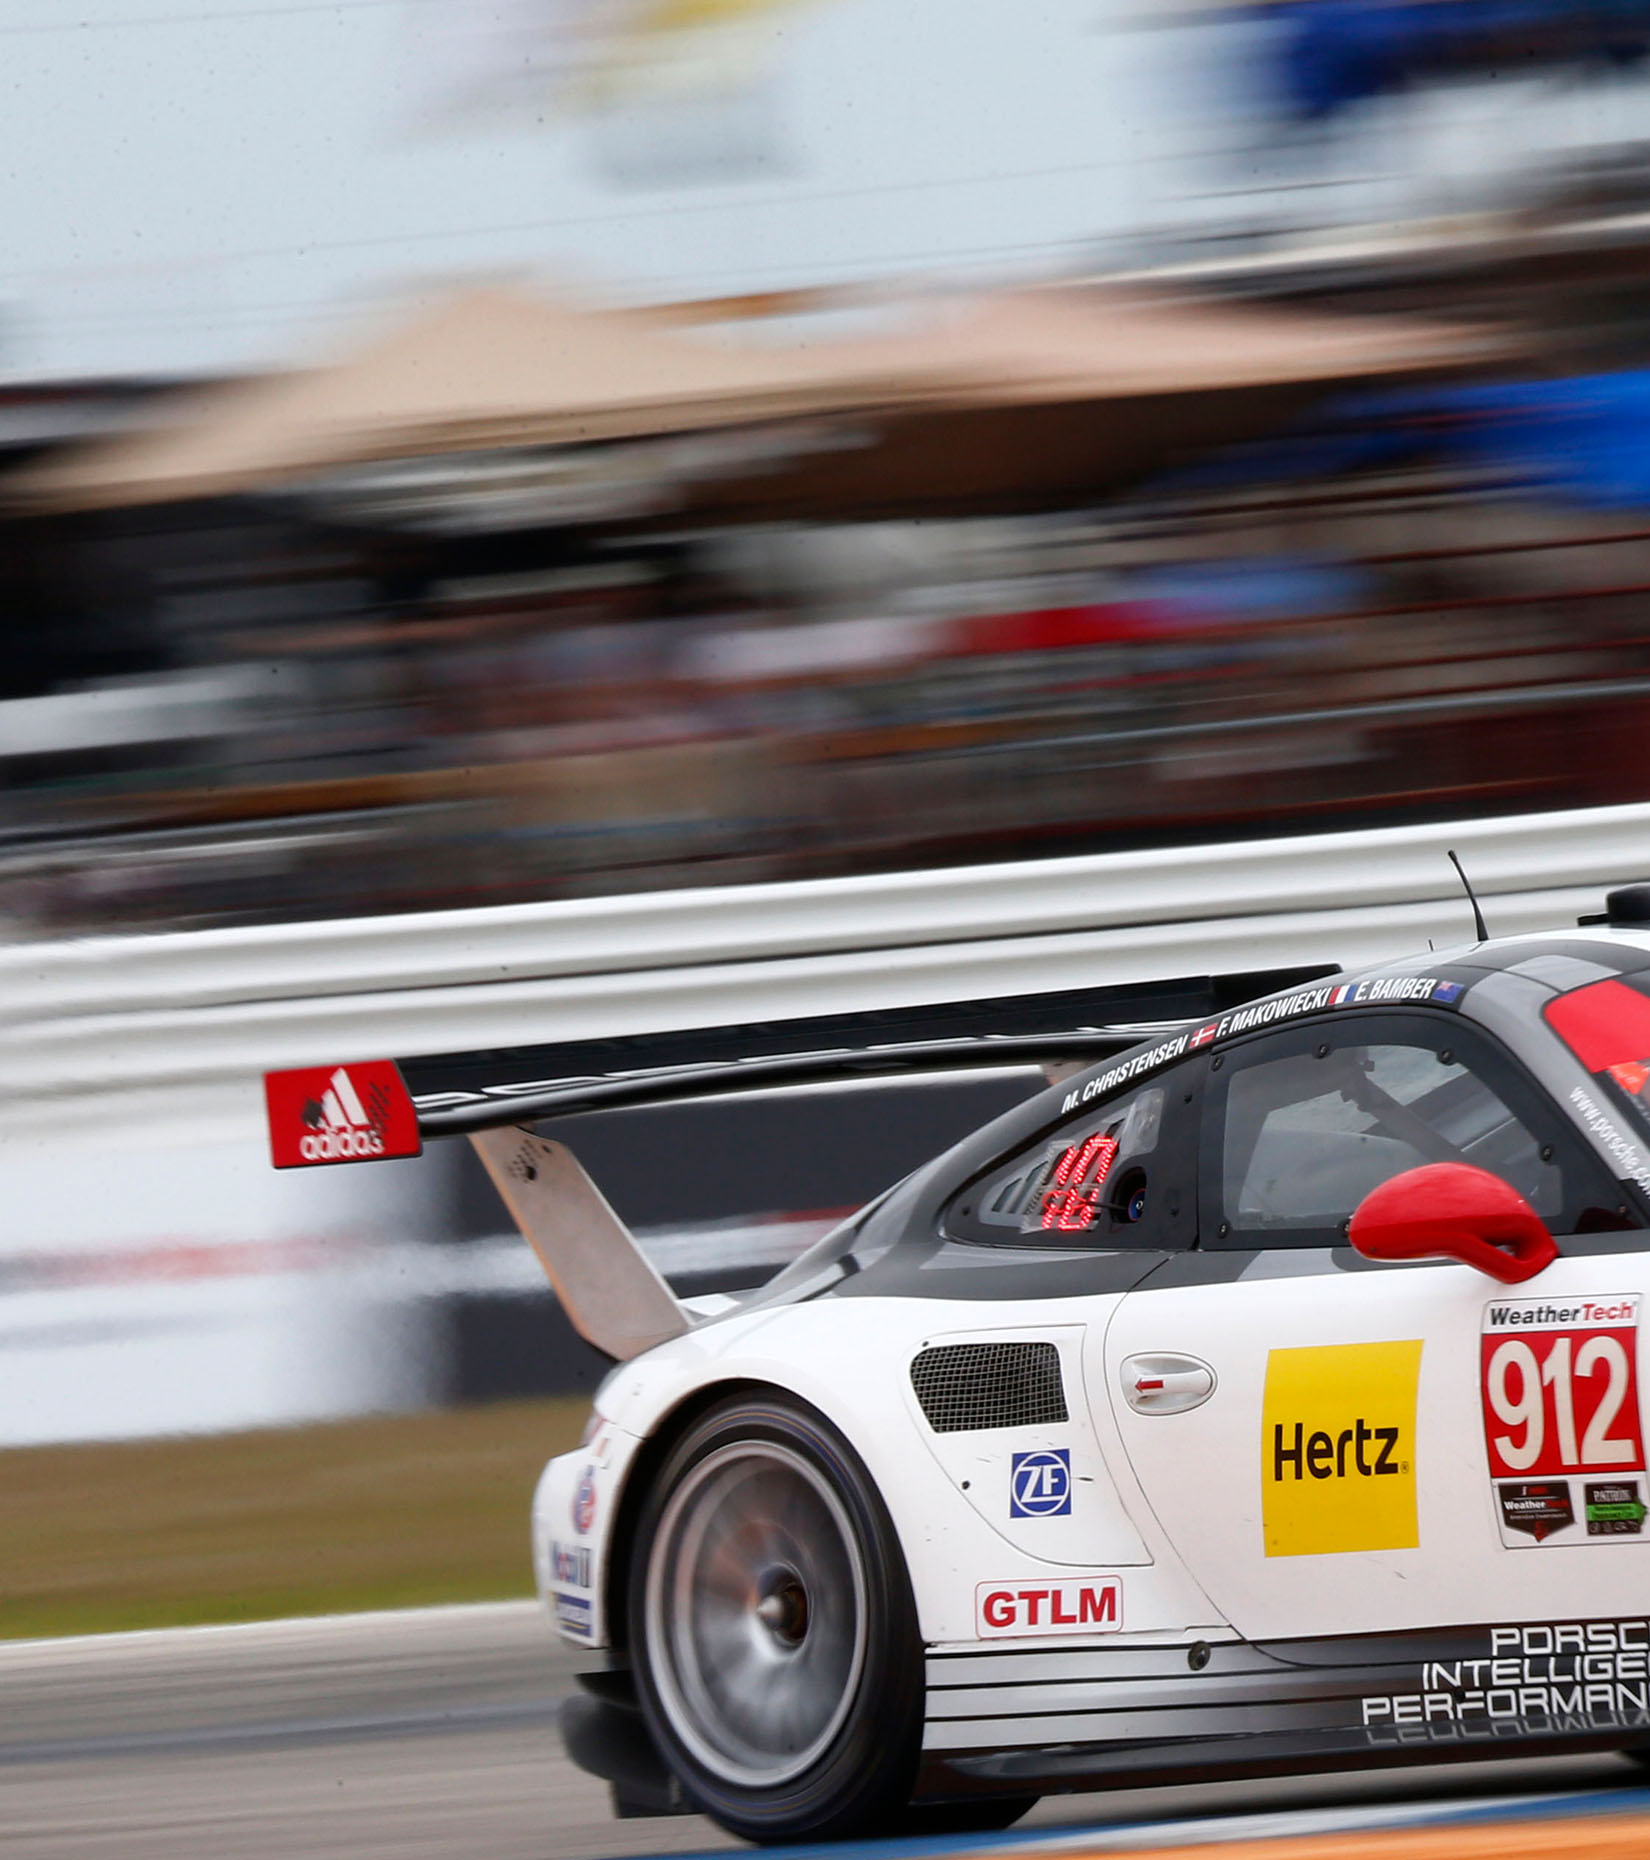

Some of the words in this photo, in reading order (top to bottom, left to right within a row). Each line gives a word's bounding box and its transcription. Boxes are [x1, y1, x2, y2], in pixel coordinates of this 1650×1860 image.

[1061, 1090, 1079, 1114] M.
[1082, 1035, 1188, 1101] CHRISTENSEN
[1216, 1014, 1229, 1037] F.
[1229, 986, 1331, 1033] MAKOWIECKI
[1353, 981, 1369, 1001] E.
[1369, 978, 1437, 1000] BAMBER
[300, 1124, 384, 1160] adidas
[1489, 1301, 1634, 1326] WeatherTech
[1488, 1335, 1637, 1471] 912
[1274, 1418, 1400, 1482] Hertz
[1018, 1464, 1065, 1503] ZF
[983, 1586, 1117, 1628] GTLM
